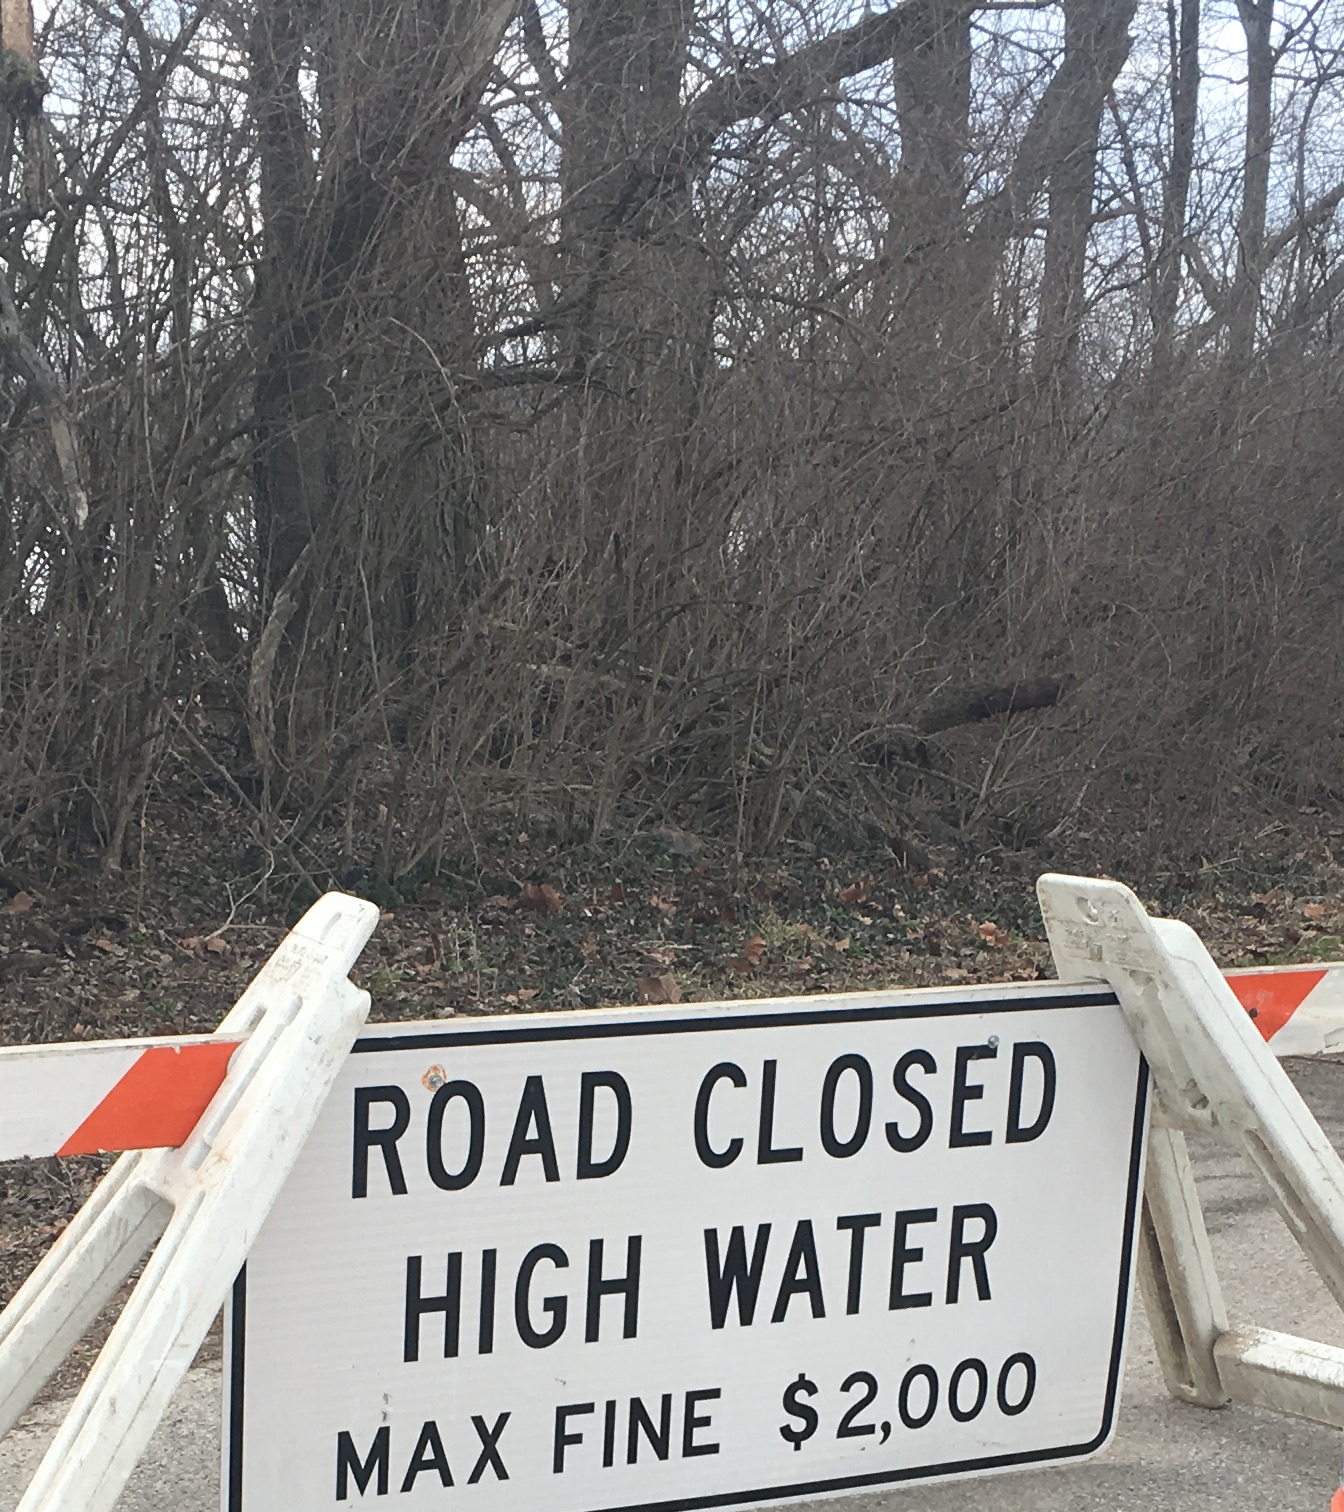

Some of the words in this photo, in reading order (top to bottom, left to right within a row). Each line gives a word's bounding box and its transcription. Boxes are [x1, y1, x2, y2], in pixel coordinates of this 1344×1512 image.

[350, 1070, 633, 1199] ROAD
[692, 1041, 1058, 1169] CLOSED
[402, 1234, 644, 1363] HIGH
[703, 1202, 999, 1330] WATER
[334, 1411, 513, 1501] MAX
[552, 1387, 723, 1474] FINE
[778, 1352, 1038, 1452] $2,000
